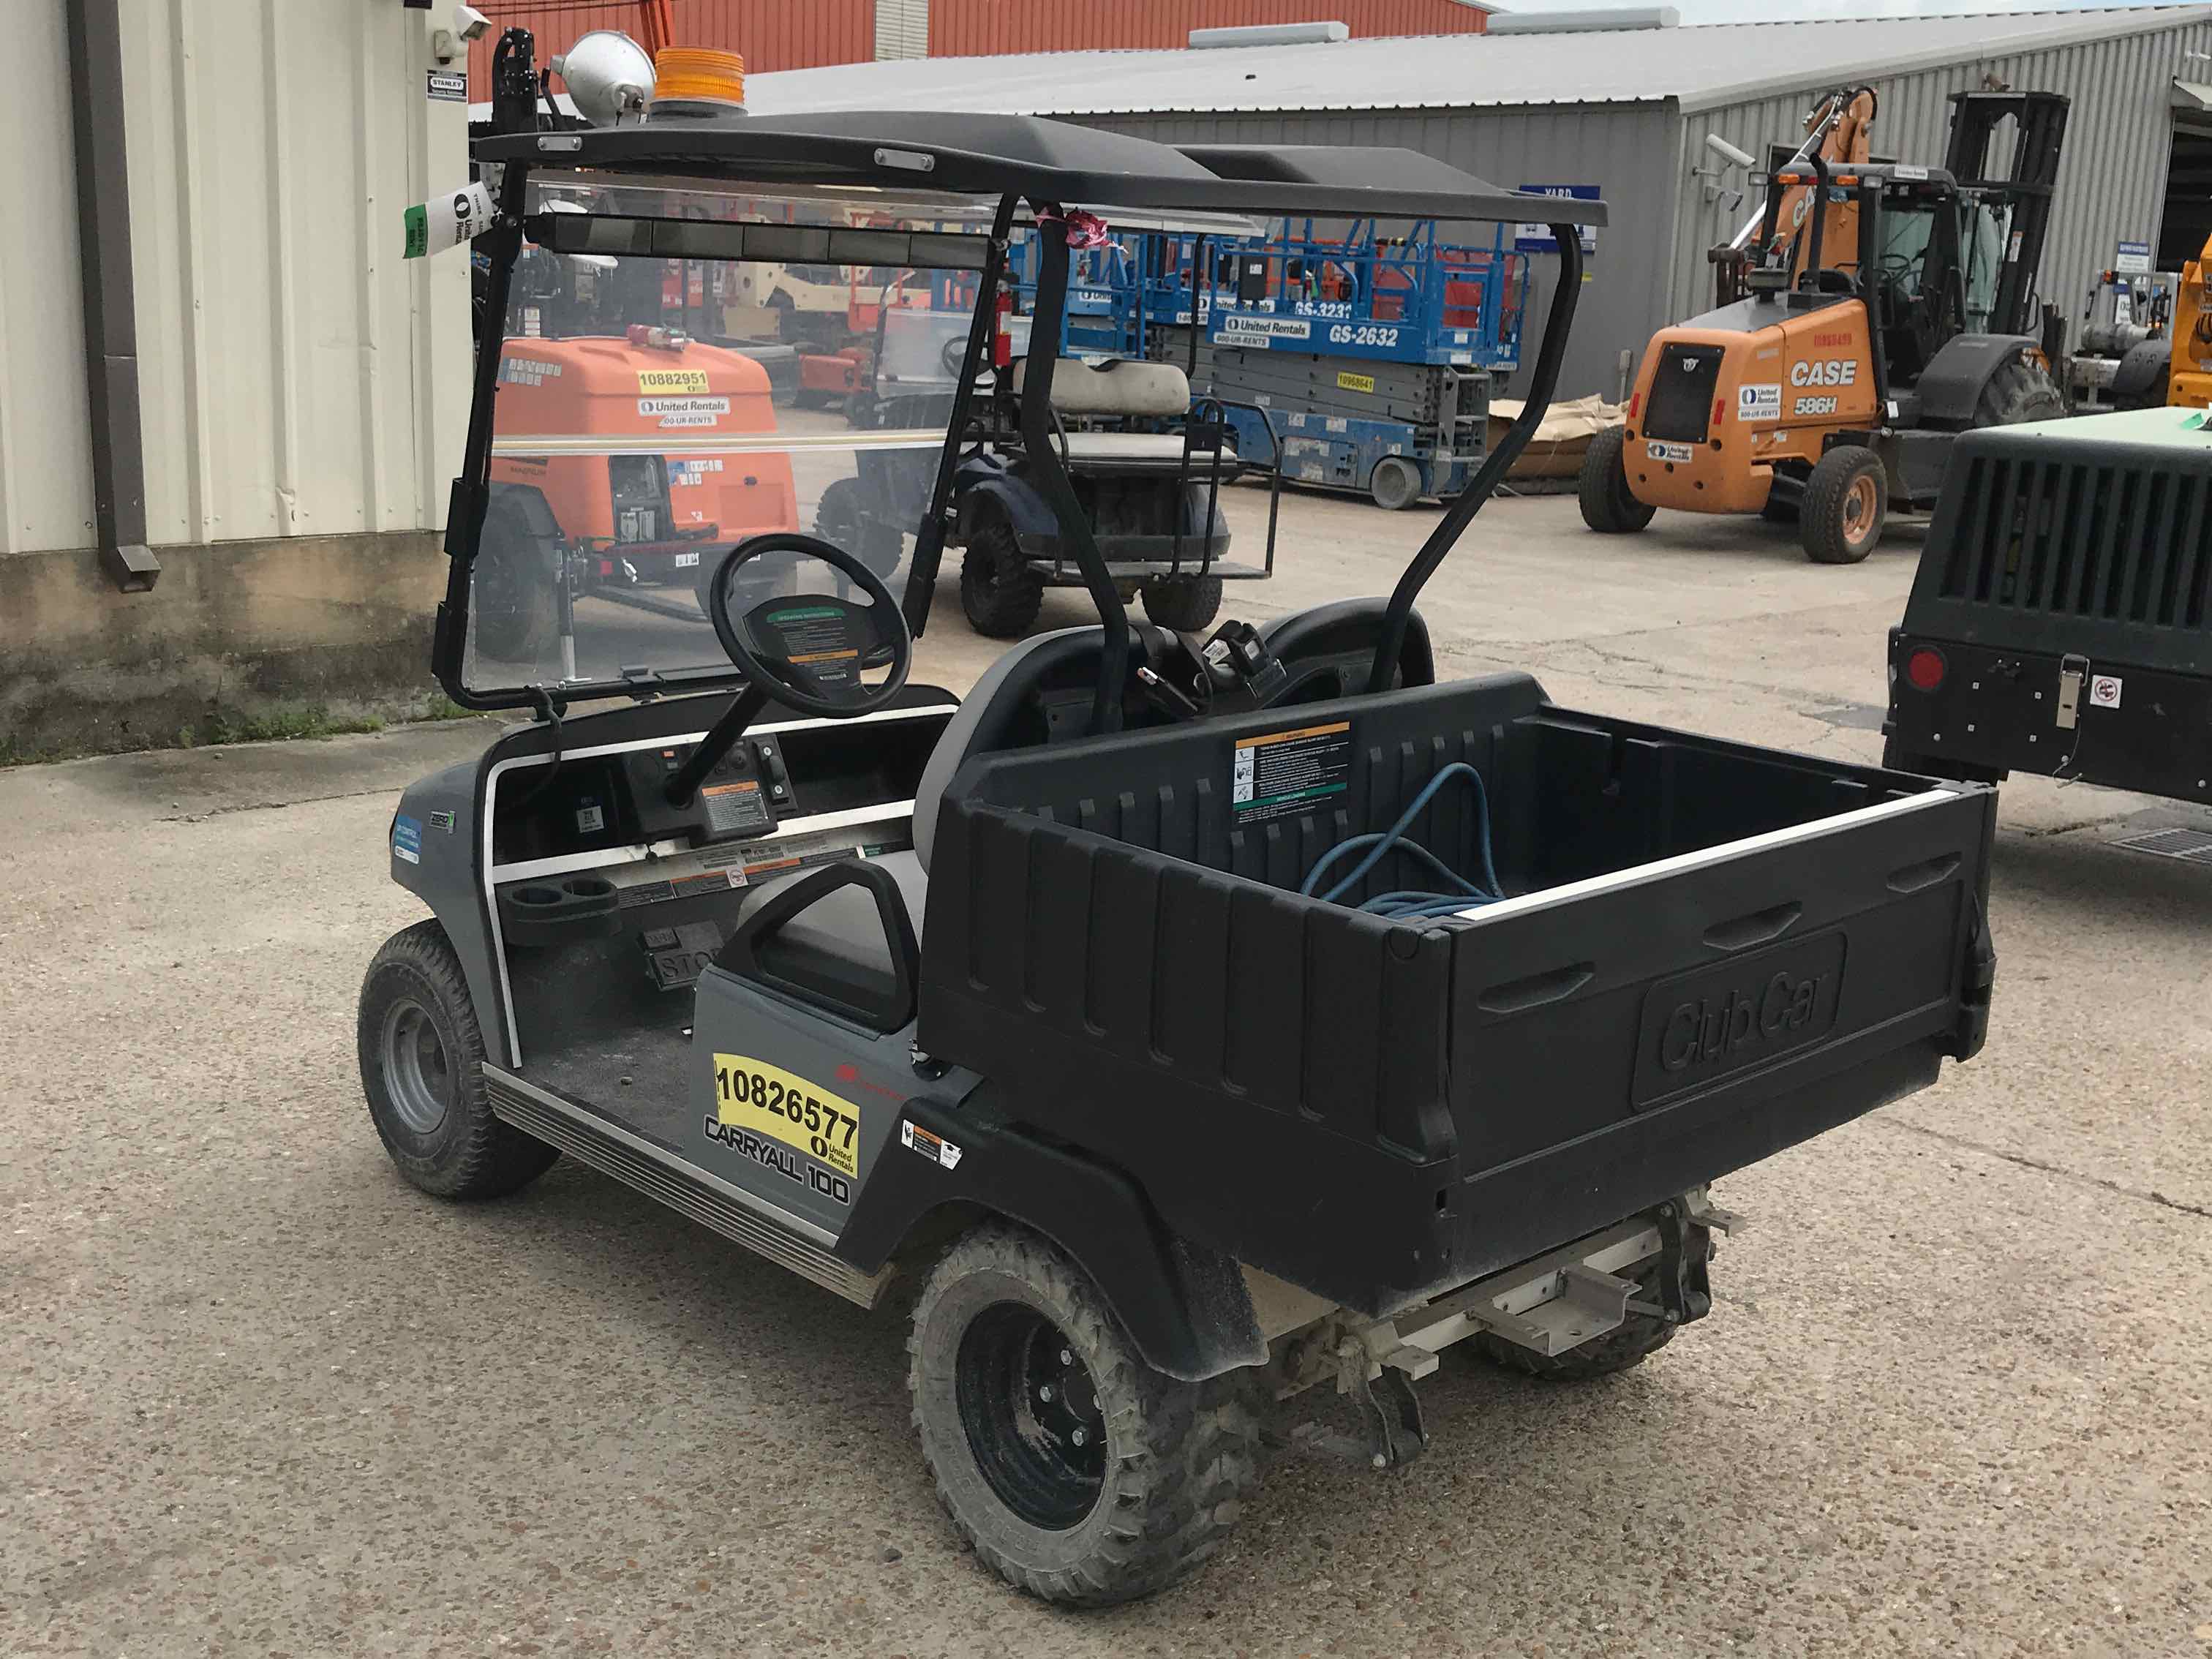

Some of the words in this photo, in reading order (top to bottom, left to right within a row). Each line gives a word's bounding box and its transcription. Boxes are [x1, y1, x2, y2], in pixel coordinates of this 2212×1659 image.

[432, 79, 462, 88] STANLEY
[1241, 320, 1271, 332] United
[1272, 324, 1306, 336] Rentals
[1329, 324, 1399, 347] GS-2632
[640, 372, 707, 385] 10882951
[1791, 360, 1857, 387] CASE
[655, 400, 689, 411] United
[691, 399, 726, 411] Rentals
[1794, 396, 1837, 415] 586H
[432, 813, 448, 824] ZERO
[661, 951, 712, 978] STO
[1661, 989, 1751, 1071] Club
[1760, 970, 1829, 1039] Car
[716, 1067, 859, 1150] 10826577
[704, 1115, 805, 1185] CARRYALL
[807, 1162, 851, 1205] 100
[828, 1143, 853, 1162] United
[827, 1154, 854, 1173] Rentals
